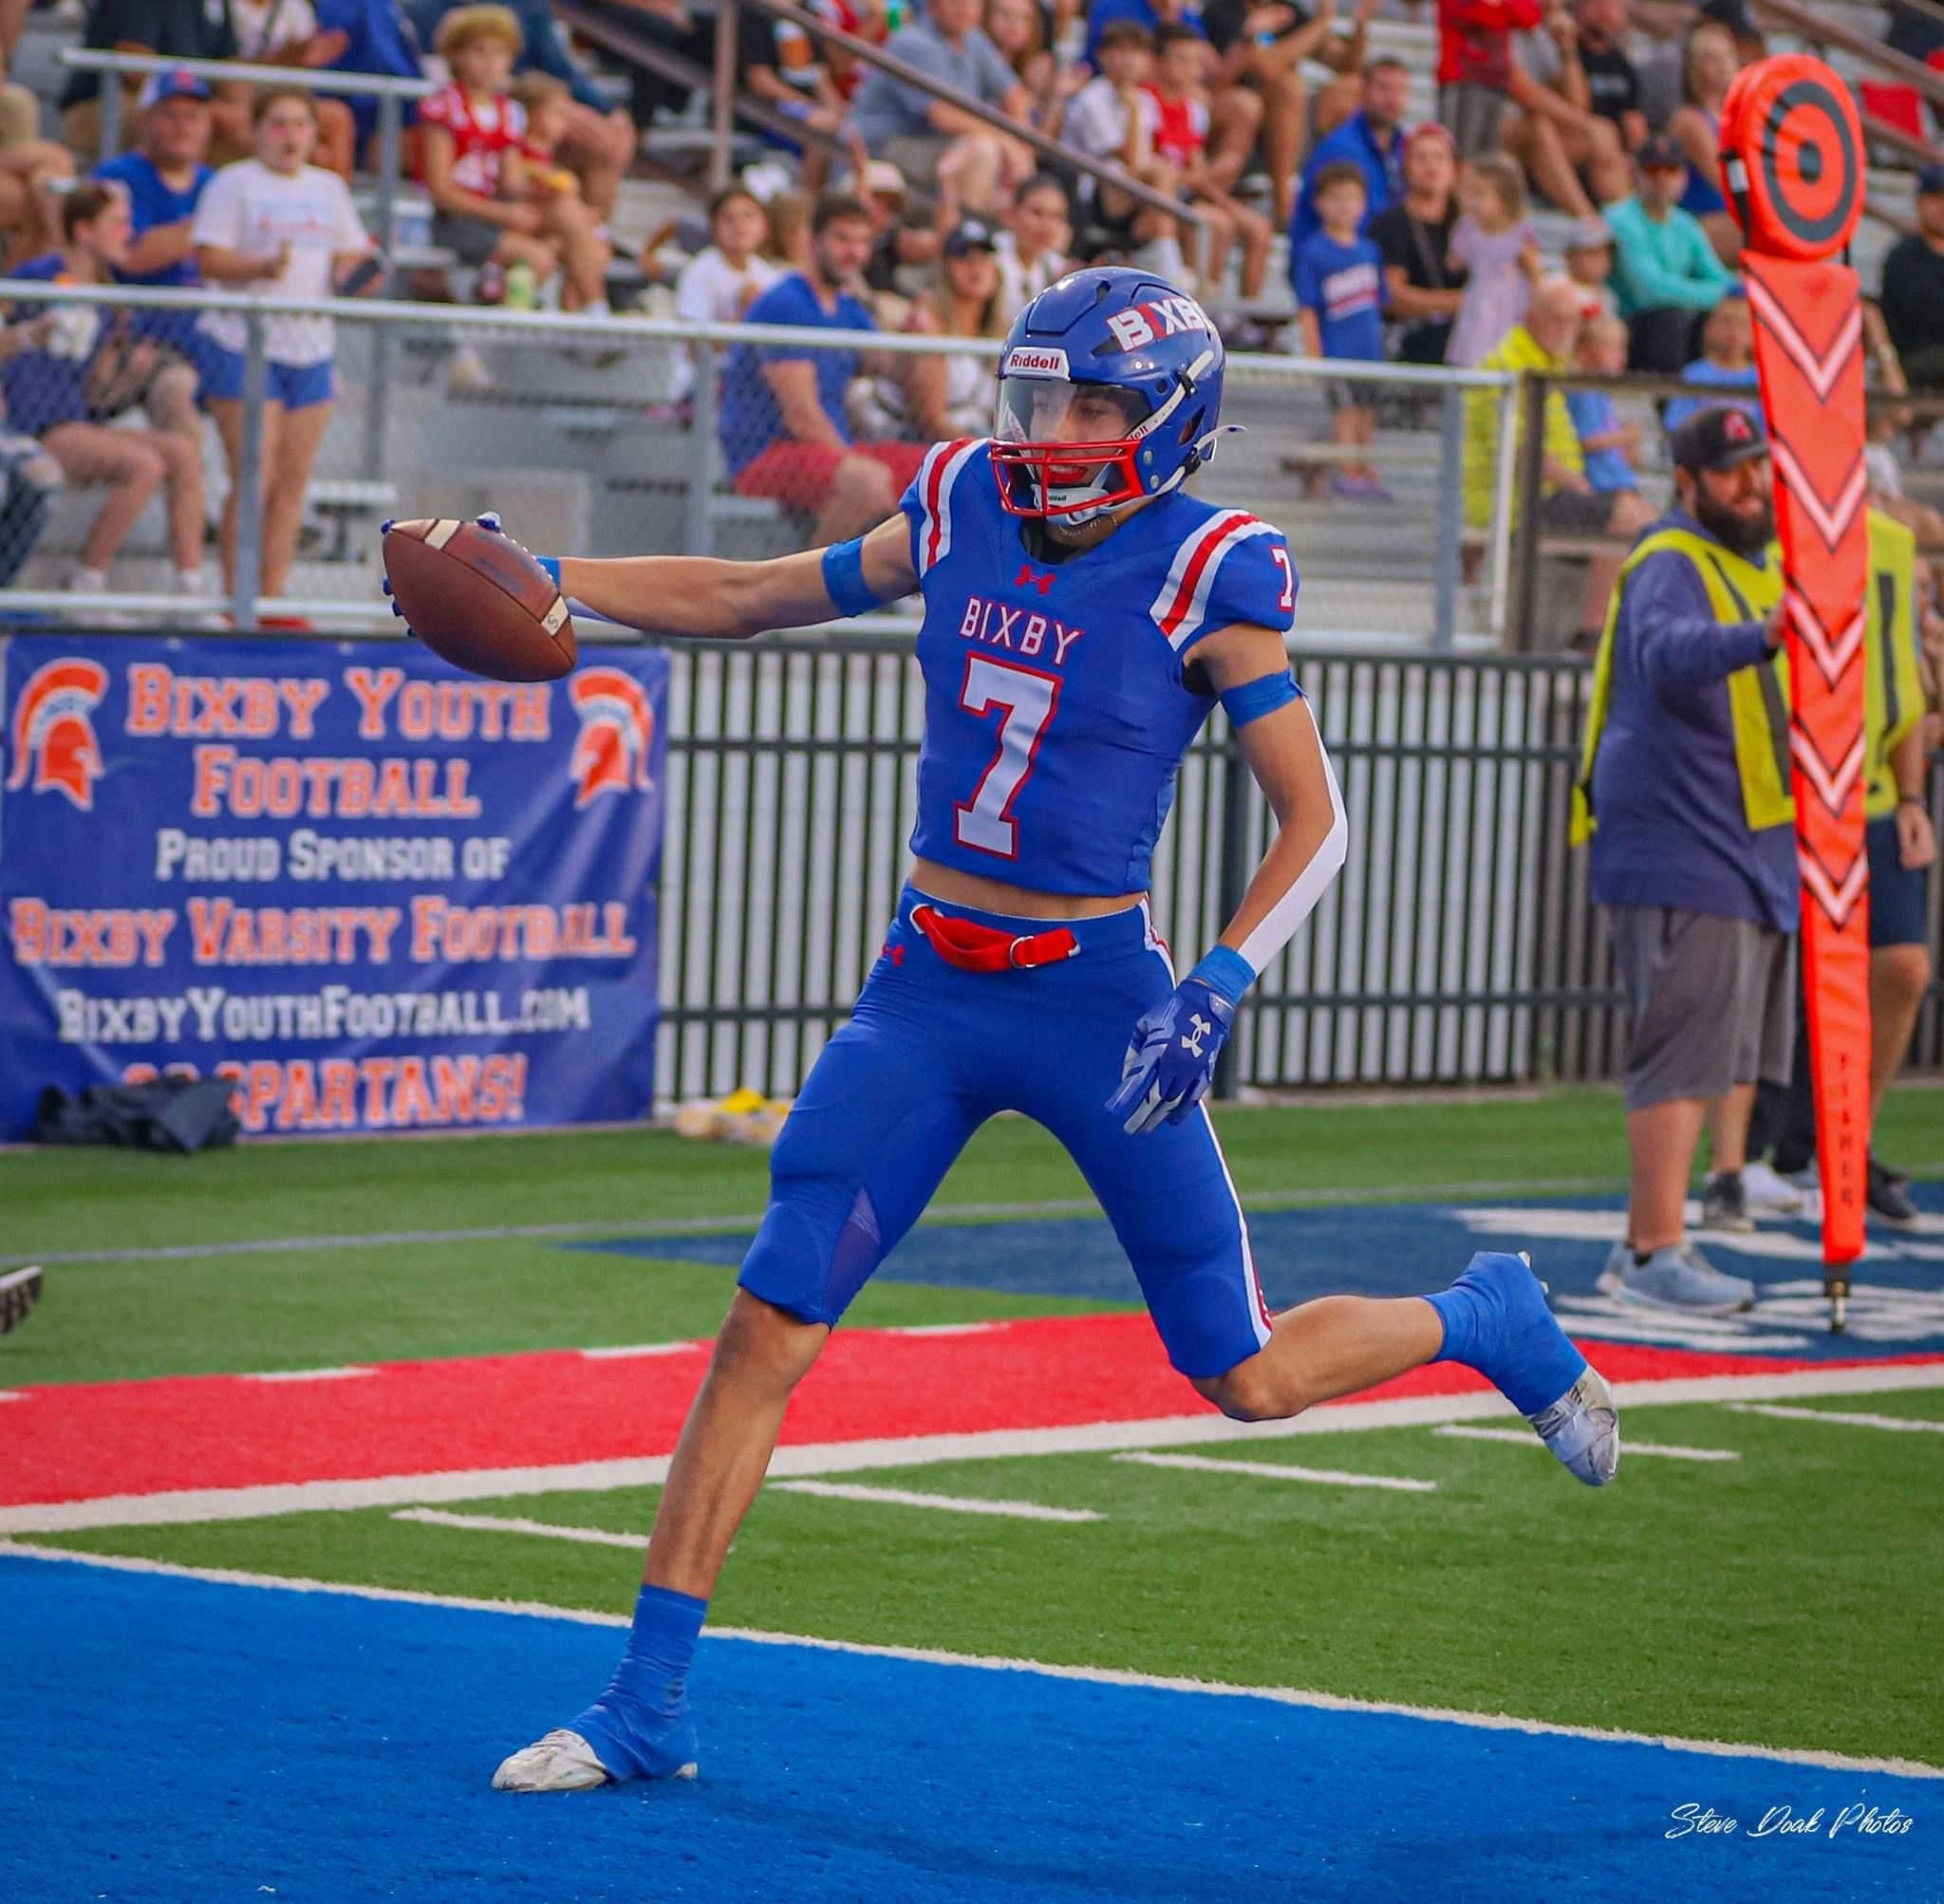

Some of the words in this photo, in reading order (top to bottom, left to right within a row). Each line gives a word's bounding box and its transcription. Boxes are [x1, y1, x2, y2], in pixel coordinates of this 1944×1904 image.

[1010, 354, 1059, 369] Riddell
[1269, 546, 1295, 612] 7
[959, 593, 1086, 666] BIXBY
[125, 663, 329, 739] BIXBY
[344, 666, 552, 743] YOUTH
[191, 745, 481, 818] FOOTBALL
[953, 650, 1064, 860] 7
[9, 896, 178, 968] BIXBY
[186, 896, 402, 966] VARSITY
[410, 893, 637, 964] FOOTBALL
